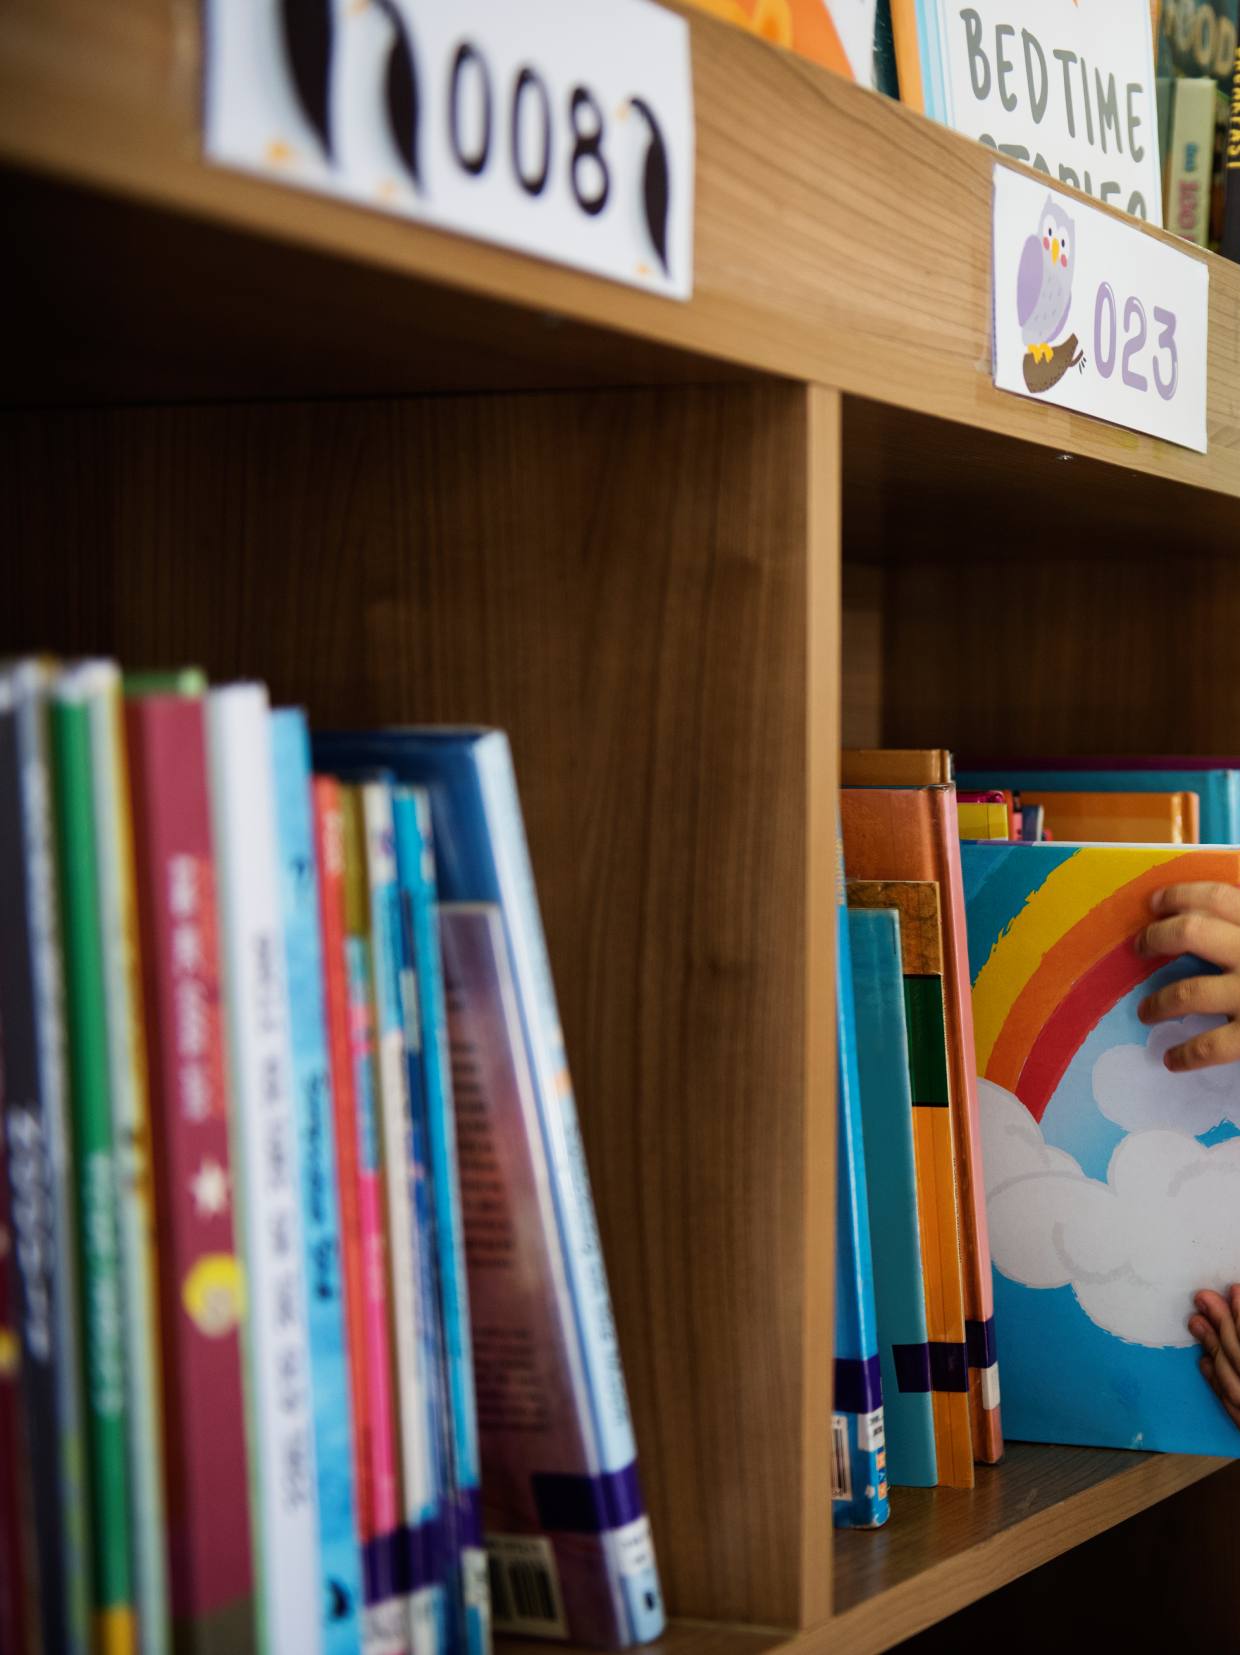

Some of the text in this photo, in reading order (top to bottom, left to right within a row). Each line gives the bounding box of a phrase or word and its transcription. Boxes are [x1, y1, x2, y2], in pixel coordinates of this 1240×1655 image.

[449, 42, 610, 217] 008
[959, 8, 1145, 163] BEDTIME
[1093, 281, 1179, 401] 023
